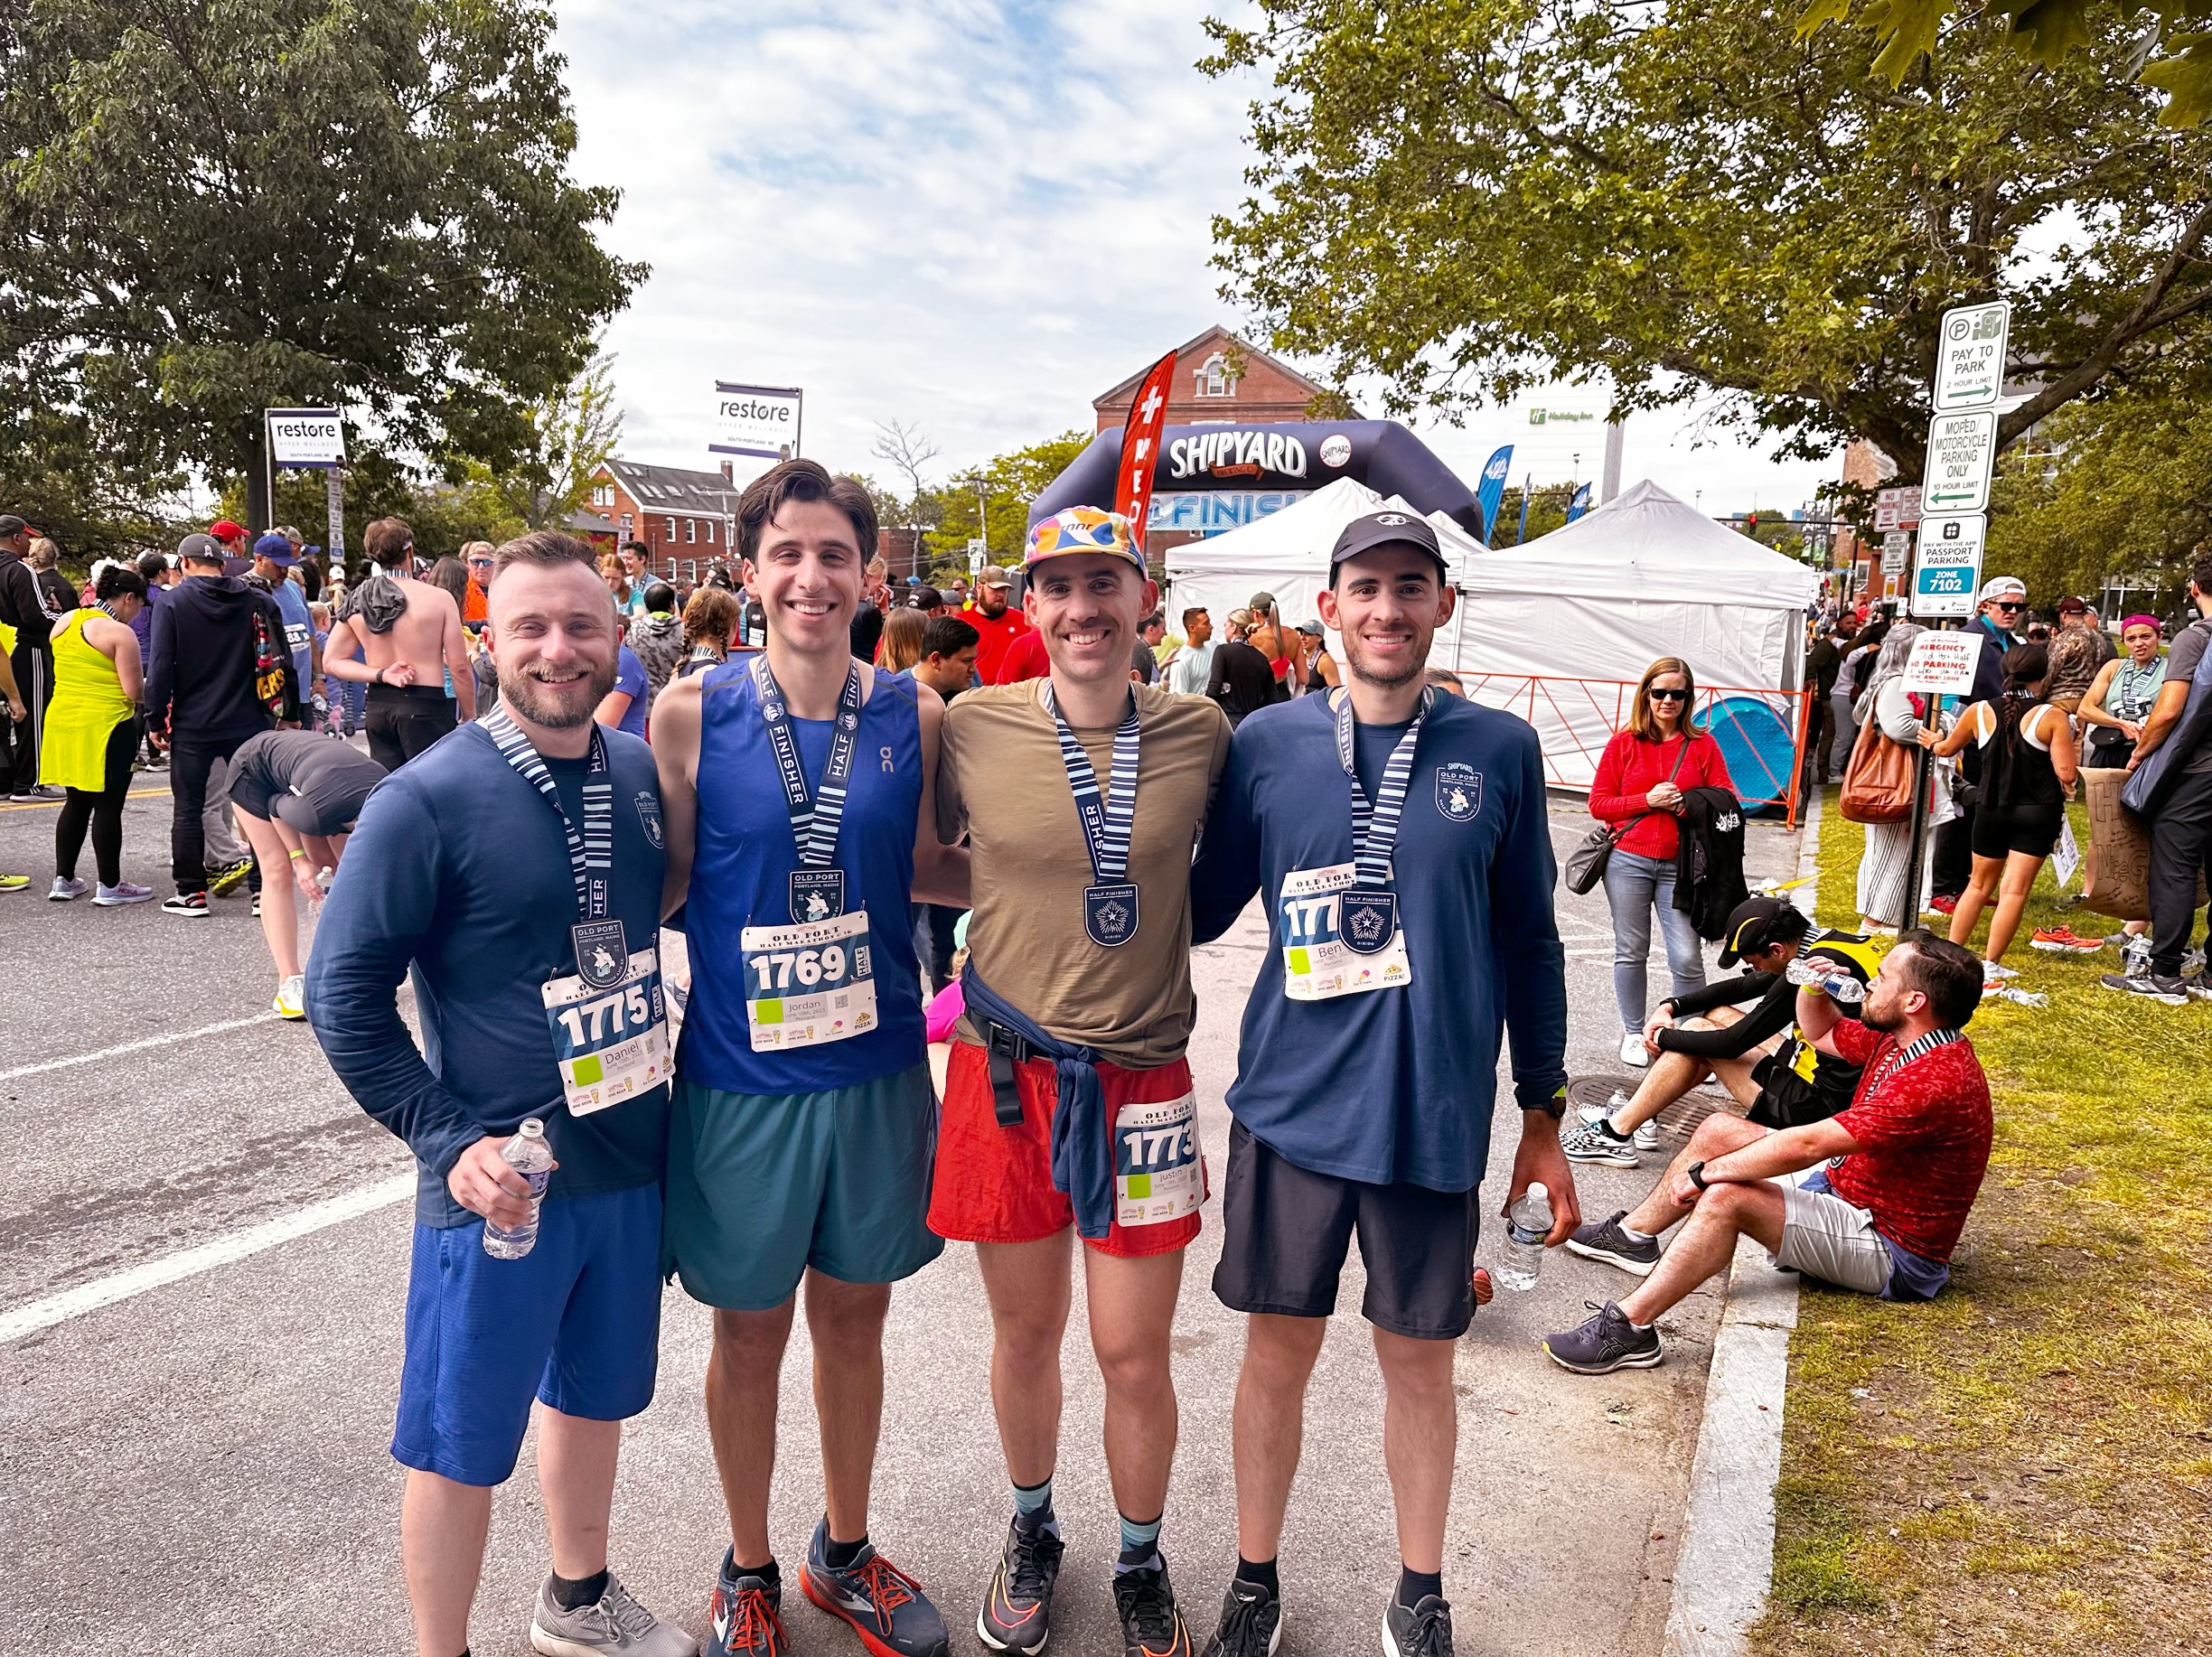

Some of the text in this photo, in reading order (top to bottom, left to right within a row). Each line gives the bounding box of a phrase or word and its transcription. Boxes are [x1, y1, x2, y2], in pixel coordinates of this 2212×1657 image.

[1952, 345, 1993, 361] PAY TO
[1954, 360, 1986, 375] PARK
[1954, 379, 1973, 388] HOUR
[1975, 376, 1992, 385] LIMIT
[719, 399, 790, 422] restore
[1548, 411, 1579, 422] Holiday
[276, 421, 335, 437] restore
[1945, 418, 1981, 435] MOPED/
[1936, 434, 1988, 451] MOTORCYCLE
[1169, 431, 1308, 480] SHIPYARD
[1321, 445, 1351, 460] SHIPYARD
[1941, 449, 1978, 464] PARKING
[1946, 463, 1970, 478] ONLY
[1963, 481, 1979, 489] LIMIT
[1885, 492, 1895, 501] NO
[1172, 494, 1309, 527] FINIS
[1879, 501, 1899, 510] PARKING
[1926, 548, 1973, 557] PASSPORT
[1927, 557, 1969, 565] PARKING
[1929, 578, 1962, 592] 7102
[1923, 661, 1966, 669] PARKING
[759, 660, 775, 698] HALF
[831, 734, 849, 777] HALF
[773, 726, 804, 803] FINISHER
[1448, 763, 1474, 774] SHIPYARD
[1086, 804, 1104, 861] SHER
[1296, 872, 1355, 887] OLD POR
[1283, 894, 1340, 937] 177
[577, 924, 619, 936] OLD PORT
[773, 925, 840, 942] OLD PORT
[786, 935, 834, 946] MARATHON
[1318, 944, 1342, 958] Ben
[748, 945, 846, 990] 1769
[857, 949, 866, 975] HALF
[1383, 974, 1405, 982] PIZZA!
[653, 986, 661, 1016] HALF
[557, 984, 649, 1047] 1775
[605, 1040, 640, 1064] Daniel
[1145, 1110, 1169, 1119] OLD
[1122, 1119, 1195, 1166] 1773
[1159, 1169, 1183, 1183] Justin
